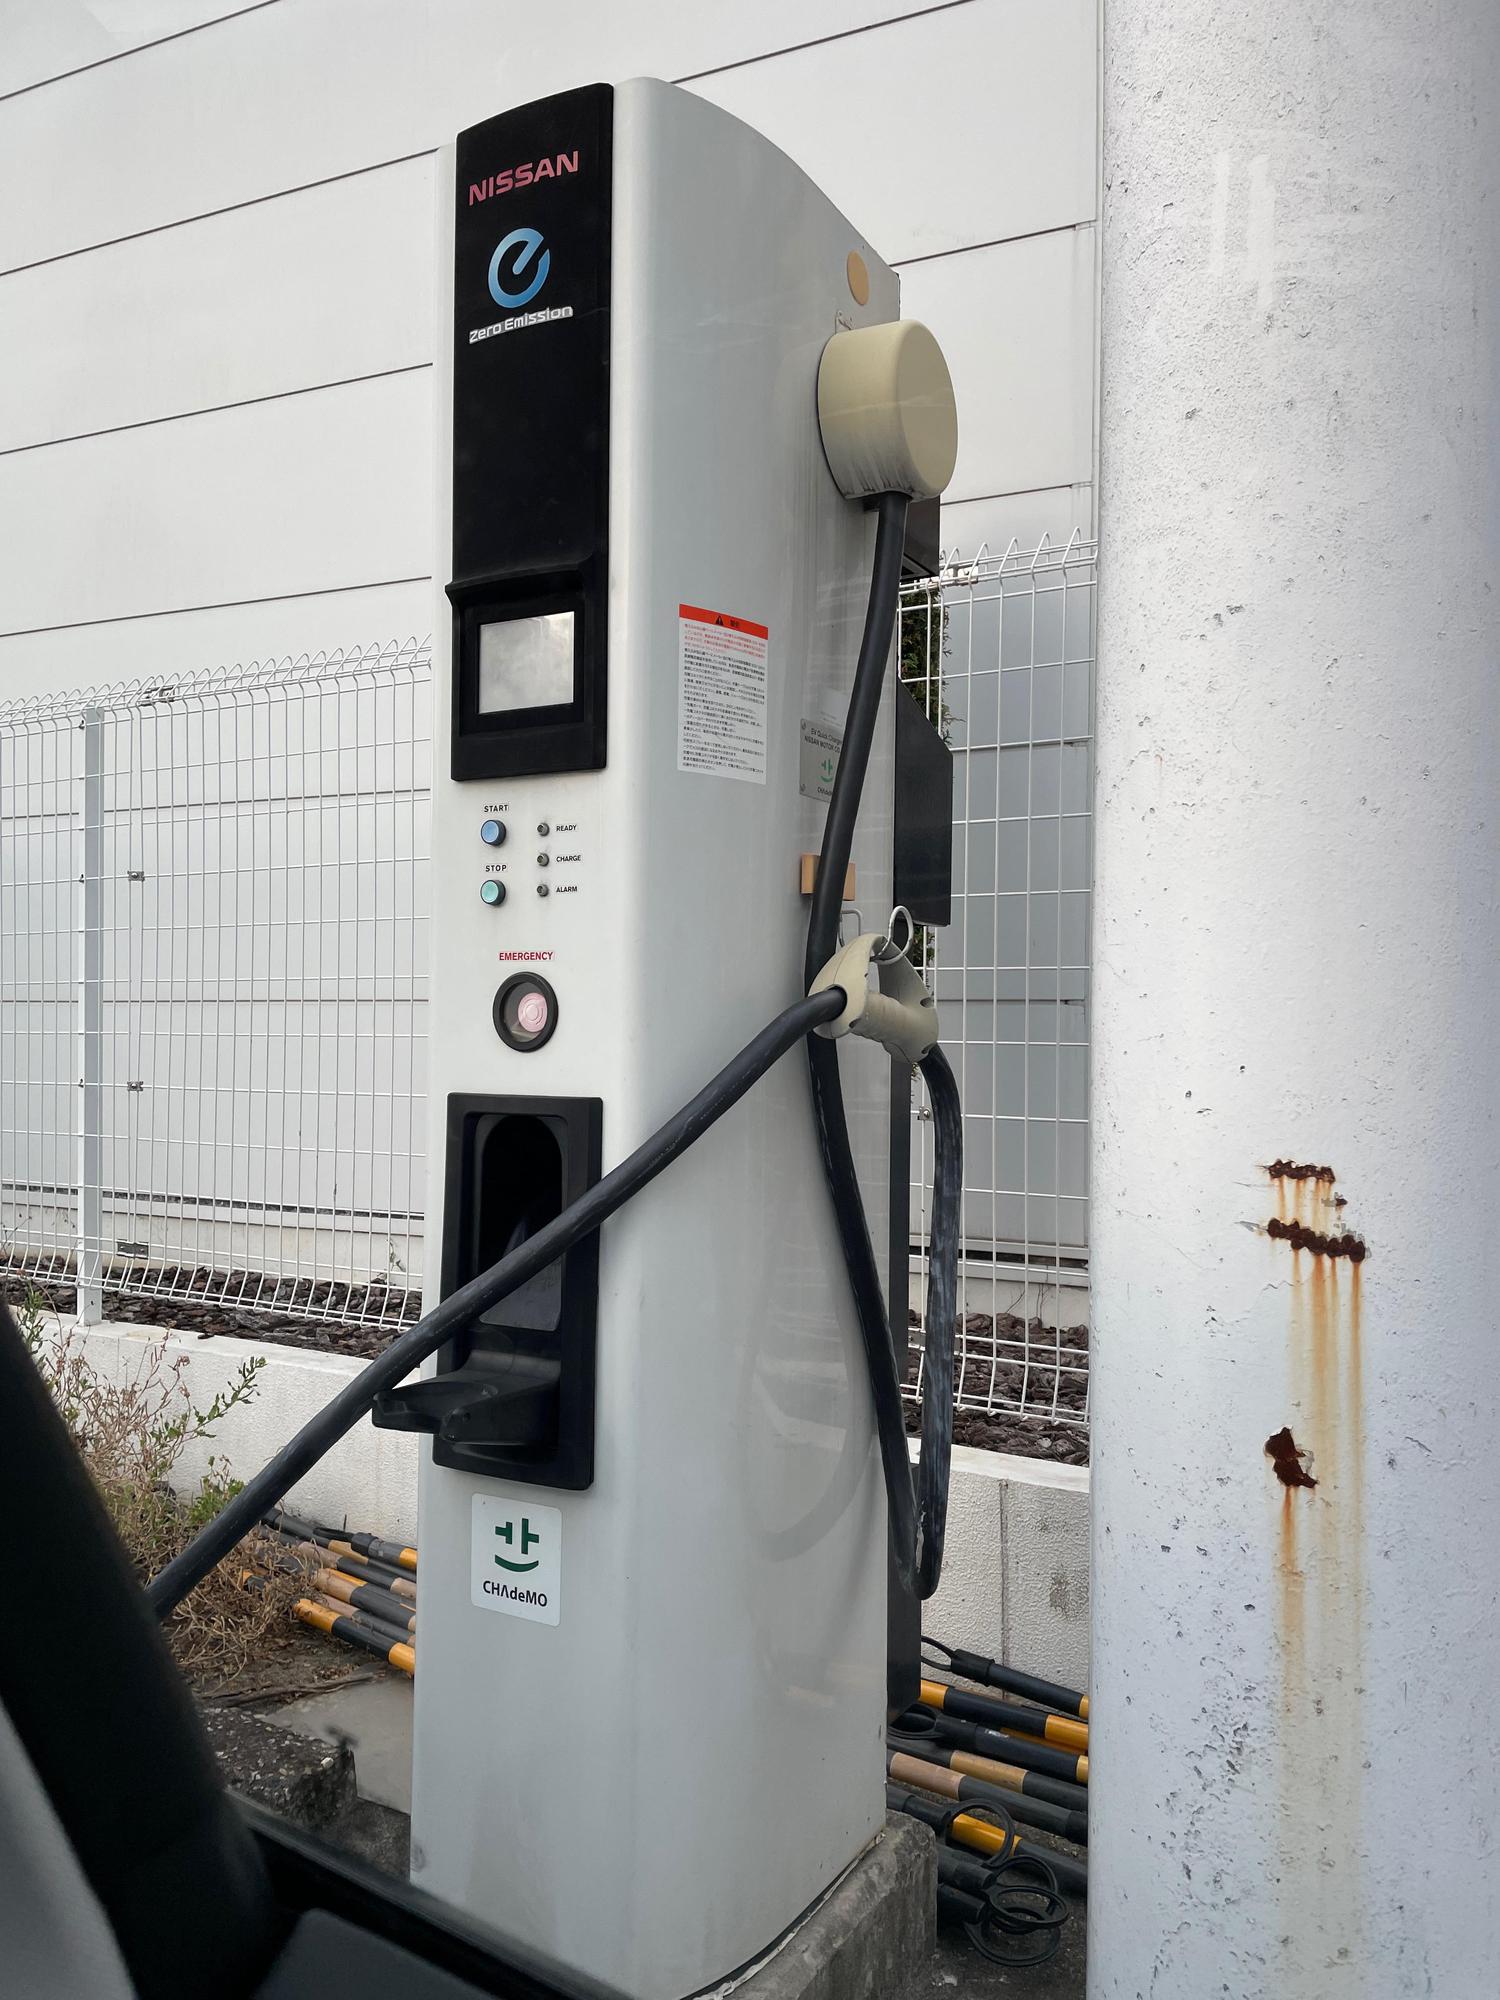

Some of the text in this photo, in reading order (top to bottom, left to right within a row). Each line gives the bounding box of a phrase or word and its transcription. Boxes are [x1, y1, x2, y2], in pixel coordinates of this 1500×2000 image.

[468, 150, 579, 206] NISSAN
[469, 305, 574, 344] Zero Emission
[484, 804, 508, 813] START
[499, 952, 553, 961] EMERGENCY
